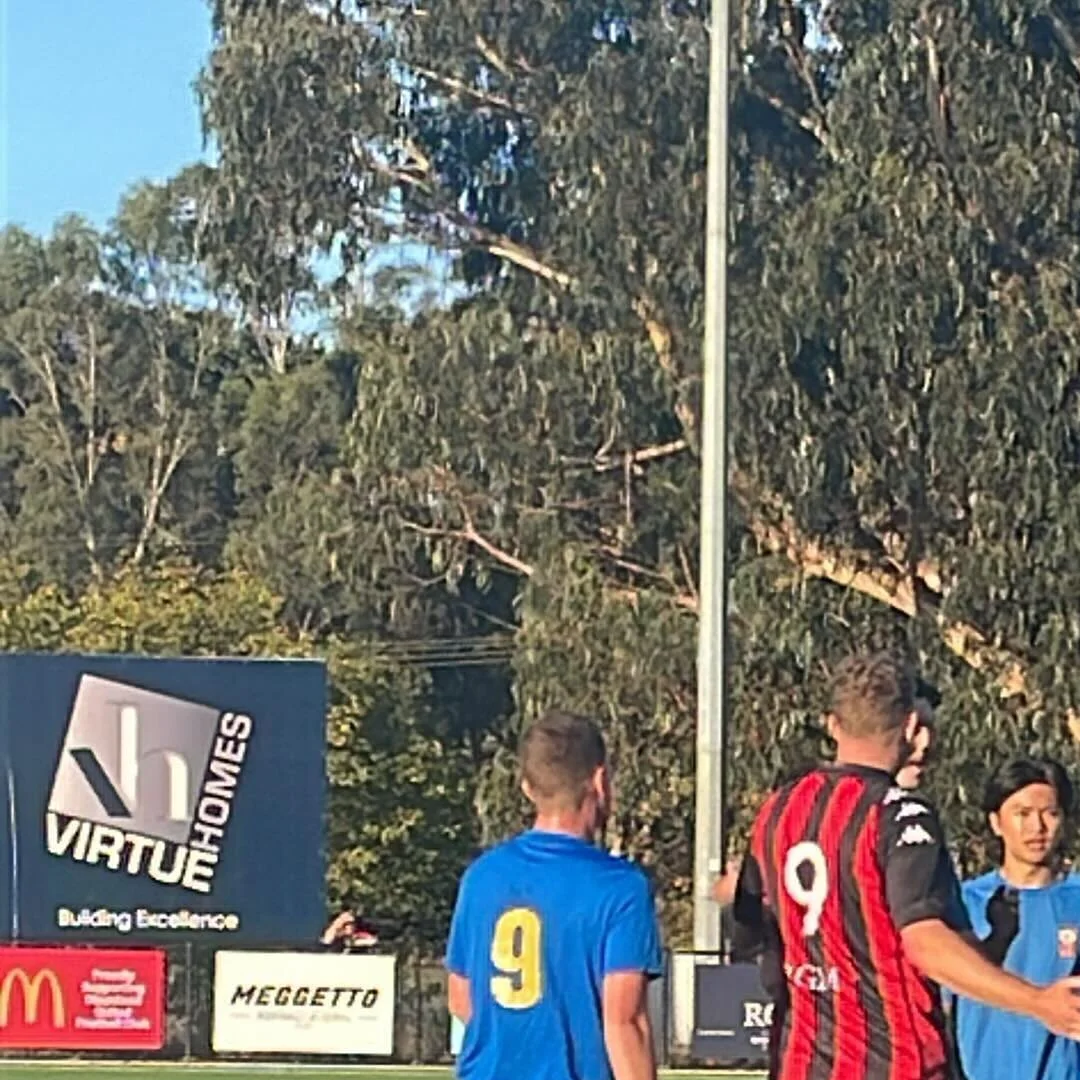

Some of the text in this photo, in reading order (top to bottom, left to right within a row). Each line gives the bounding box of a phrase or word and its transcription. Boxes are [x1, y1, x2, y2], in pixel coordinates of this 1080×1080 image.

[190, 711, 253, 851] HOMES
[45, 812, 219, 894] VIRTUE
[783, 841, 828, 936] 9
[58, 908, 239, 932] Building Excellence
[490, 908, 542, 1009] 9
[230, 985, 380, 1009] MEGGETTO
